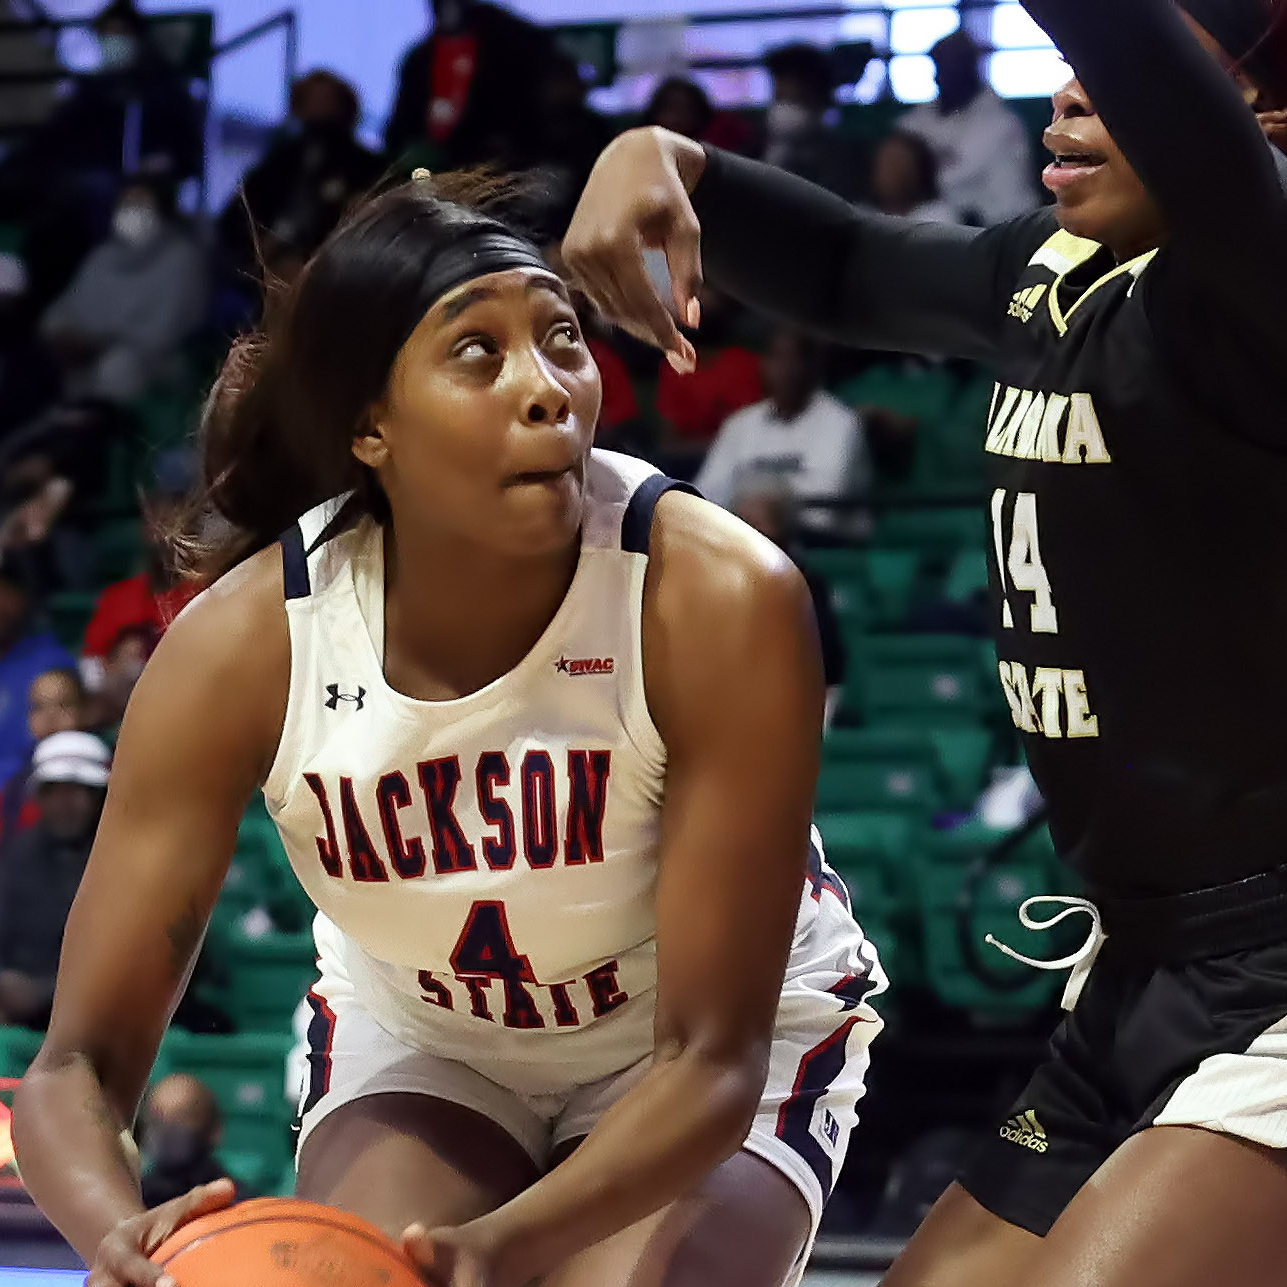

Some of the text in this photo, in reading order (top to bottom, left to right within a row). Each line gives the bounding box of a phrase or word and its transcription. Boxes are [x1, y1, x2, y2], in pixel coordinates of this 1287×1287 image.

[991, 488, 1059, 634] 14
[302, 748, 613, 882] JACKSON
[449, 899, 538, 985] 4
[417, 959, 629, 1029] STATE
[999, 1125, 1049, 1153] adidas
